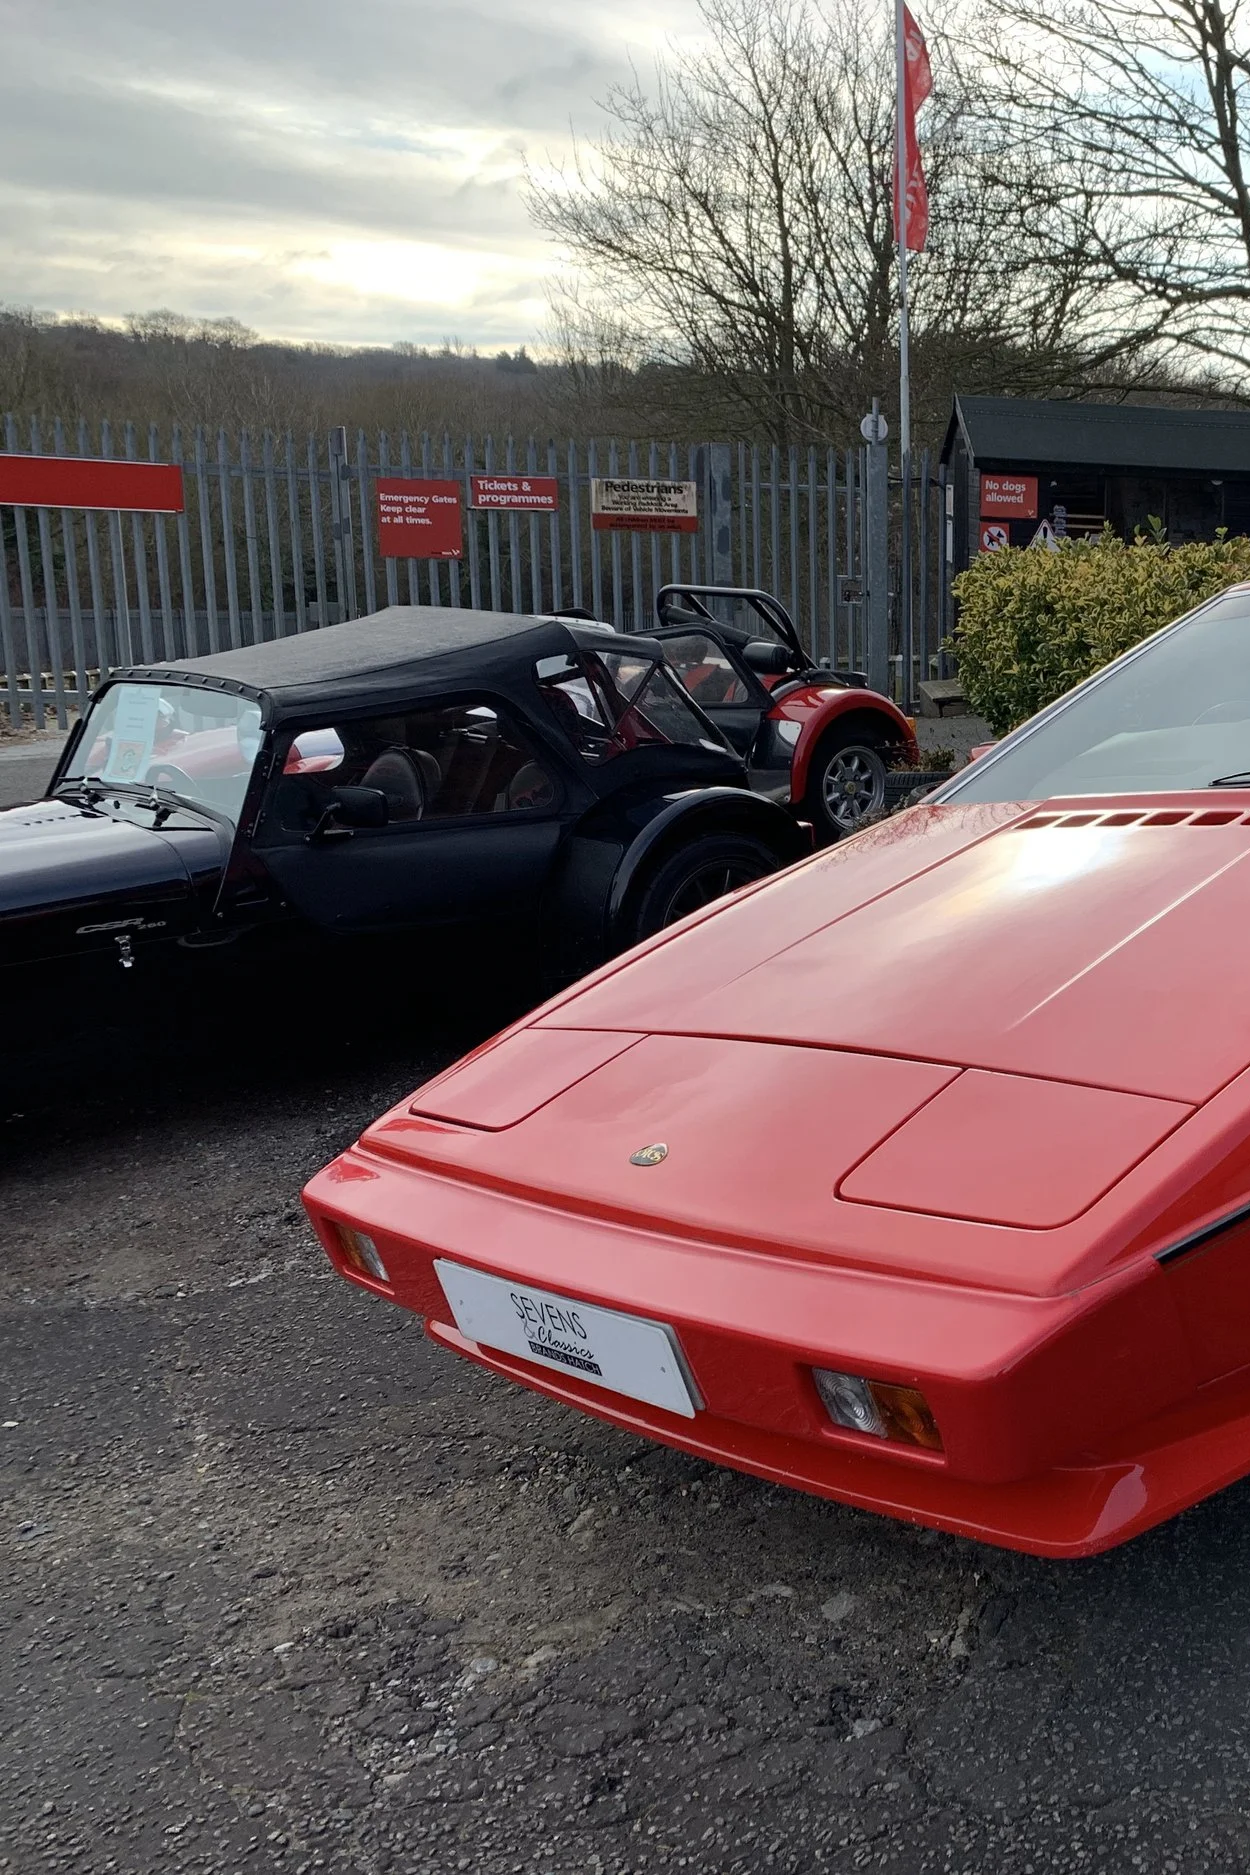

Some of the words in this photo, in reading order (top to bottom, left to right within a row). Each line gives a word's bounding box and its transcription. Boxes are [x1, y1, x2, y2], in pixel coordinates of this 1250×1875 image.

[477, 480, 519, 492] Tickets
[521, 481, 532, 492] &
[605, 481, 684, 494] Pedestrians
[985, 480, 999, 490] No
[1002, 480, 1026, 493] dogs
[379, 493, 430, 505] Emergency
[431, 494, 457, 504] Gates
[477, 493, 554, 505] programmes
[985, 492, 1024, 503] allowed
[380, 504, 403, 515] Keep
[404, 504, 426, 514] clear
[381, 515, 391, 524] at
[393, 515, 404, 524] all
[405, 516, 433, 525] times.
[509, 1292, 588, 1340] SEVENS
[537, 1327, 595, 1360] Classics
[531, 1343, 566, 1362] BRANDS
[567, 1357, 601, 1375] HATCH
